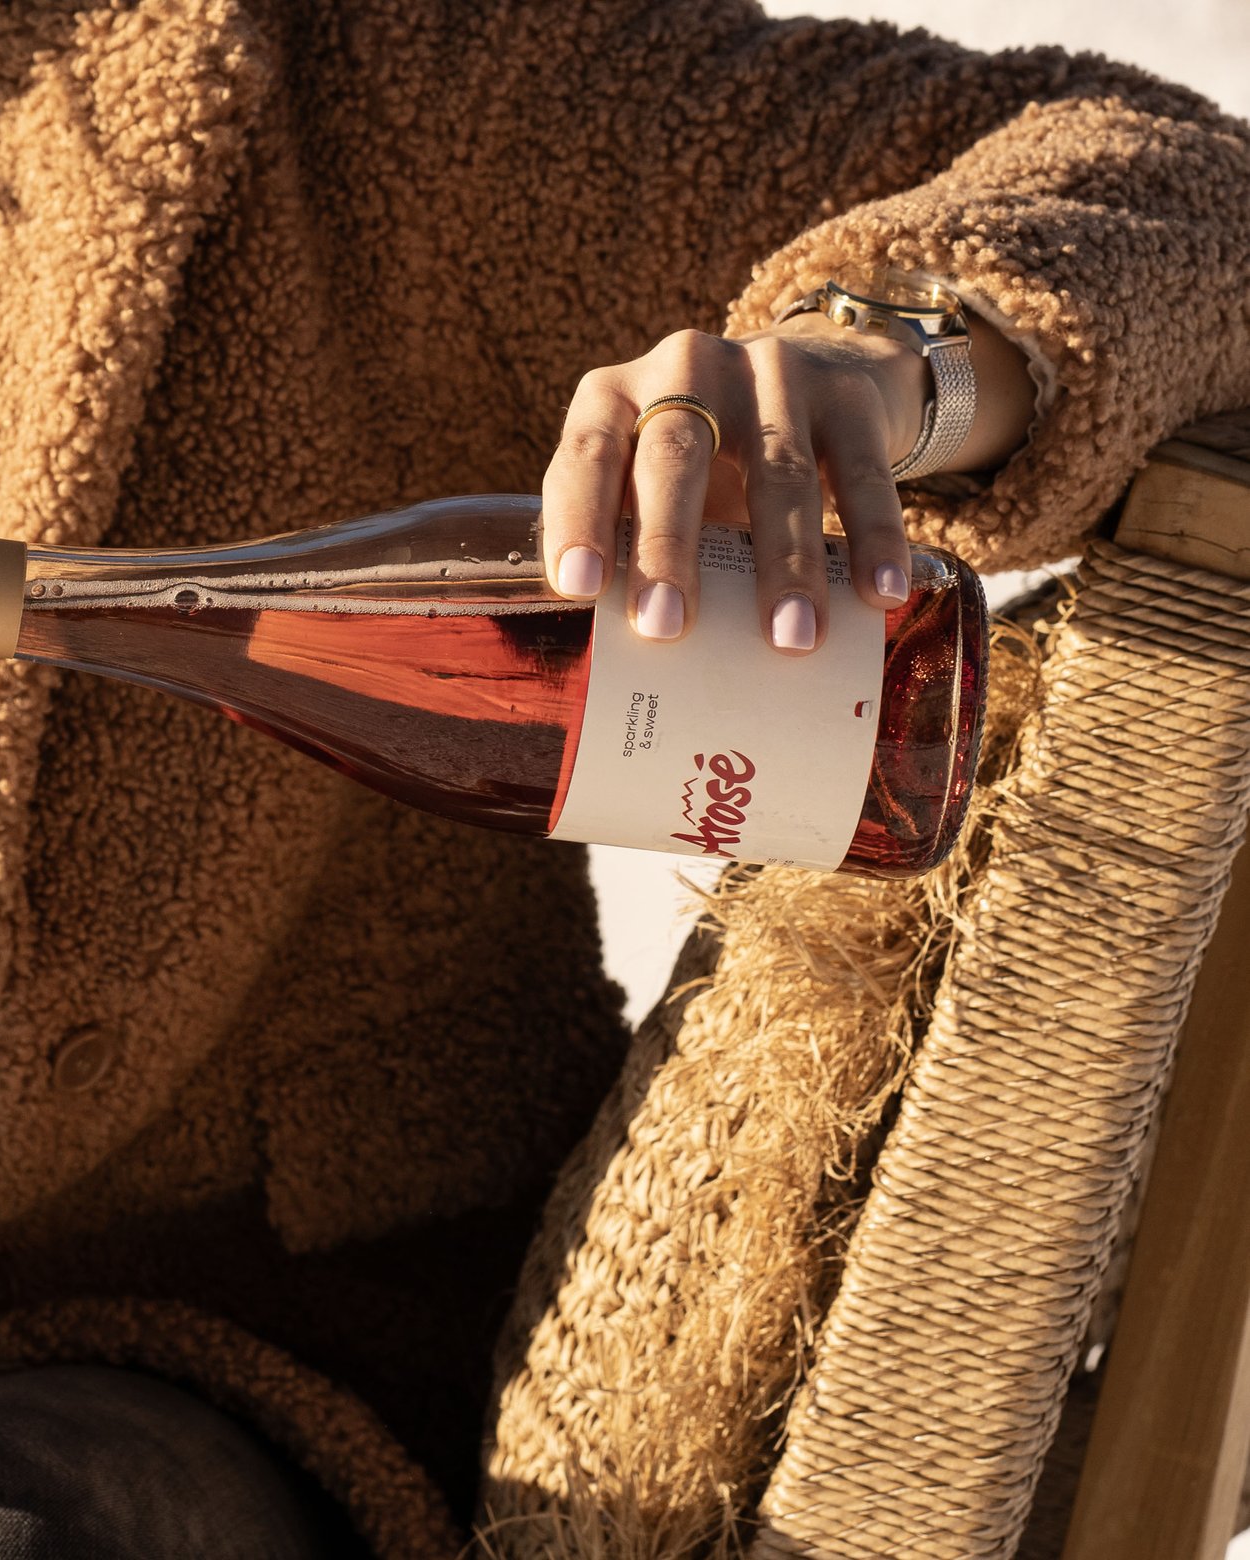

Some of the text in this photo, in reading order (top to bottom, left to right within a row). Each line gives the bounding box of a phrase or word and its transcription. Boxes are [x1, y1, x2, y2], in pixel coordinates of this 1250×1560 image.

[709, 545, 734, 554] des
[623, 692, 644, 757] sparkling
[639, 693, 658, 750] & sweet
[670, 750, 755, 858] Arosé
